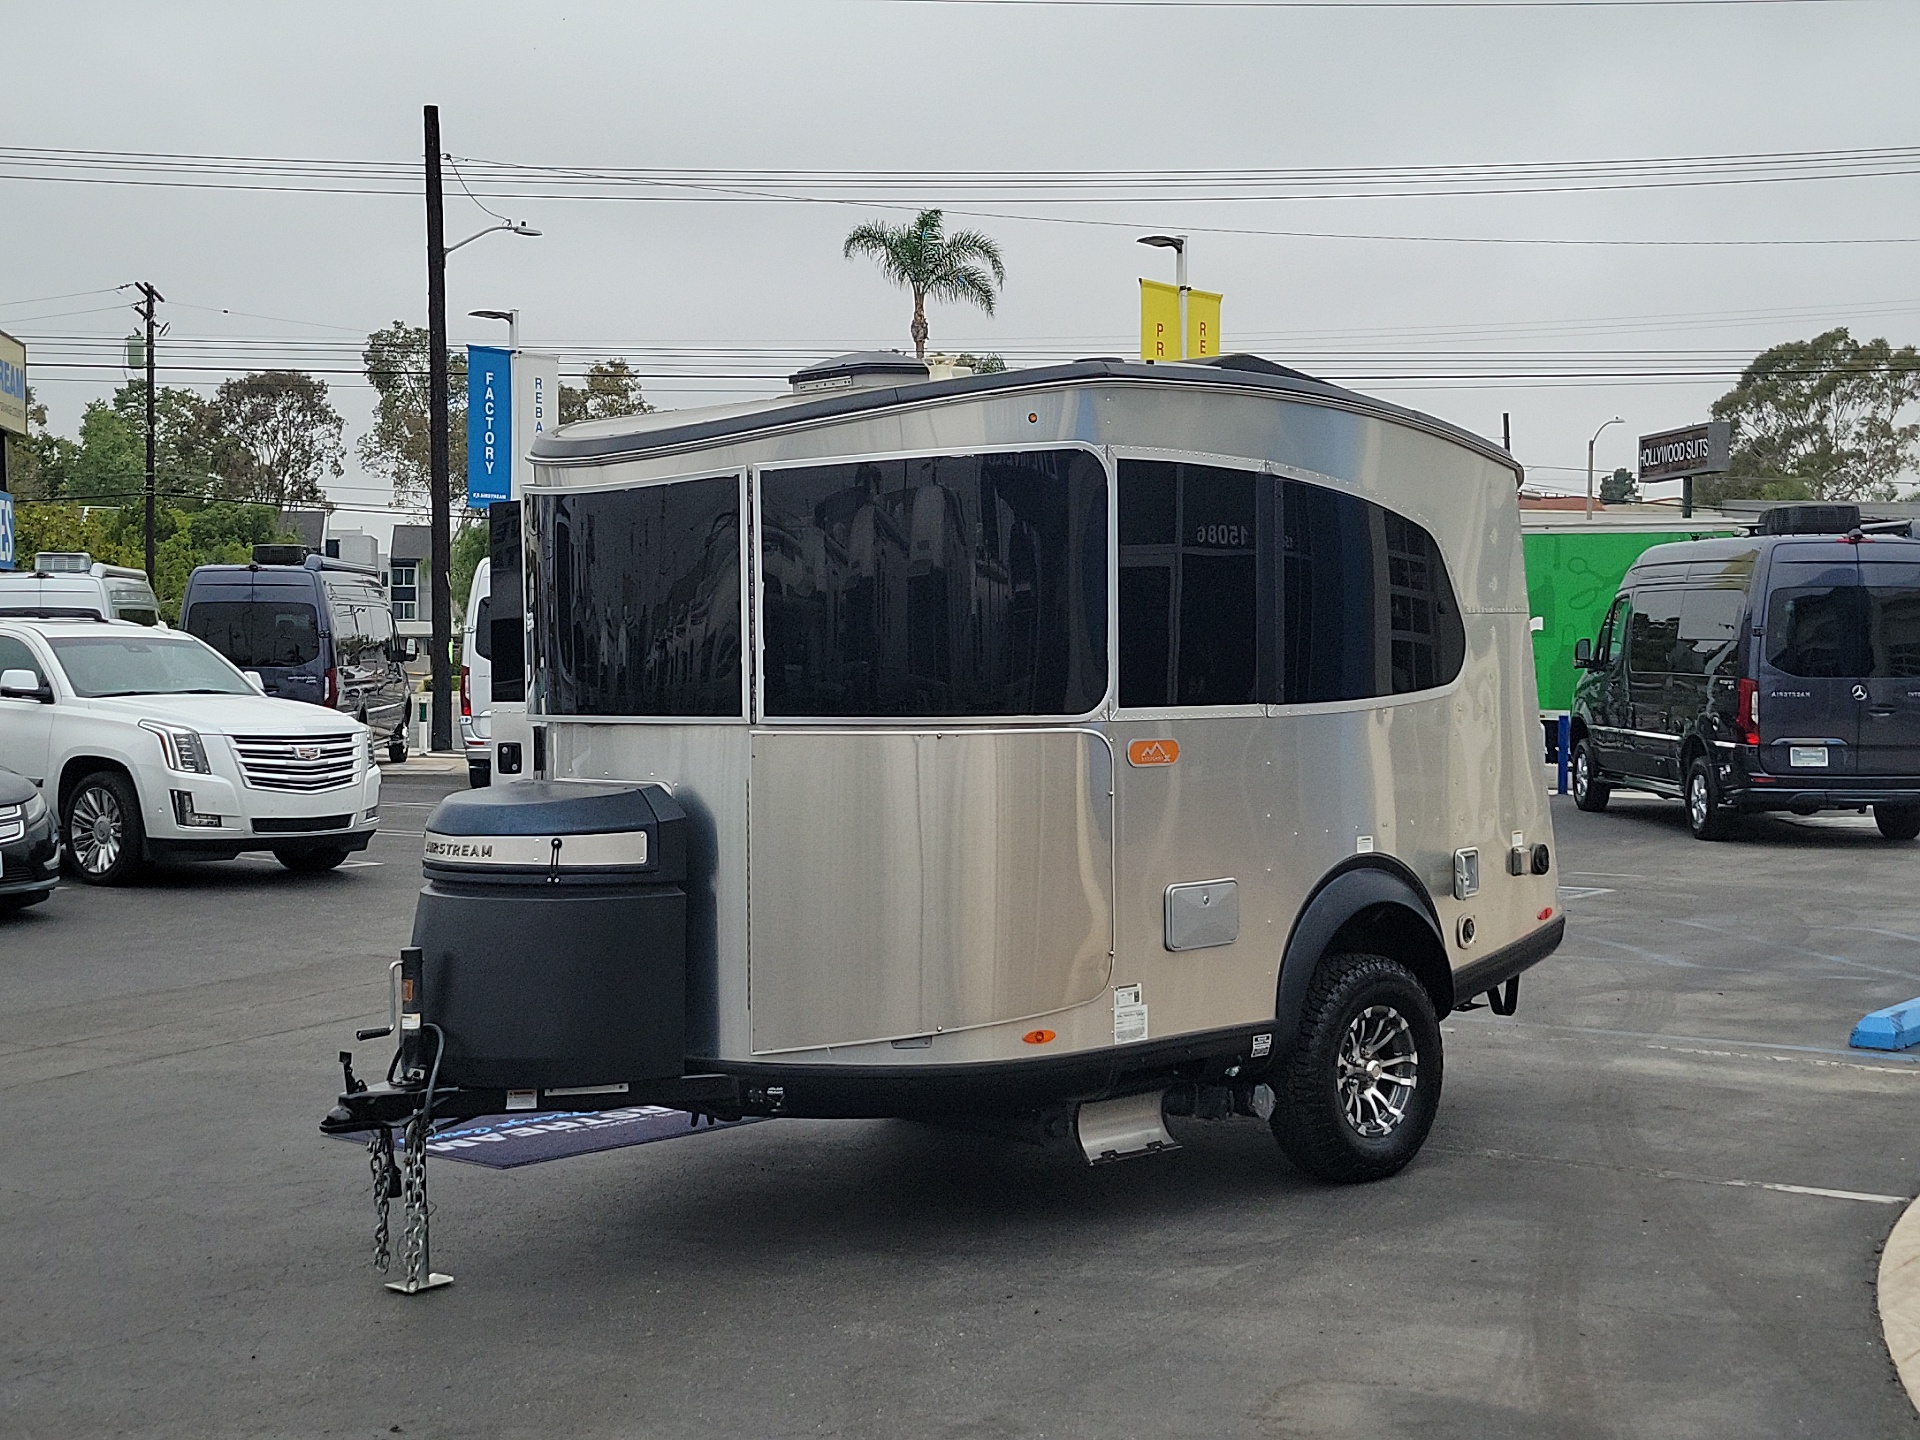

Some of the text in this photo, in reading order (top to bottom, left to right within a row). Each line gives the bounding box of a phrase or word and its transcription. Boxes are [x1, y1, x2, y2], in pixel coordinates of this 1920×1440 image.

[485, 372, 495, 475] FACTORY
[535, 377, 543, 433] REBA
[1640, 438, 1709, 467] HOLLYWOOD SUITS
